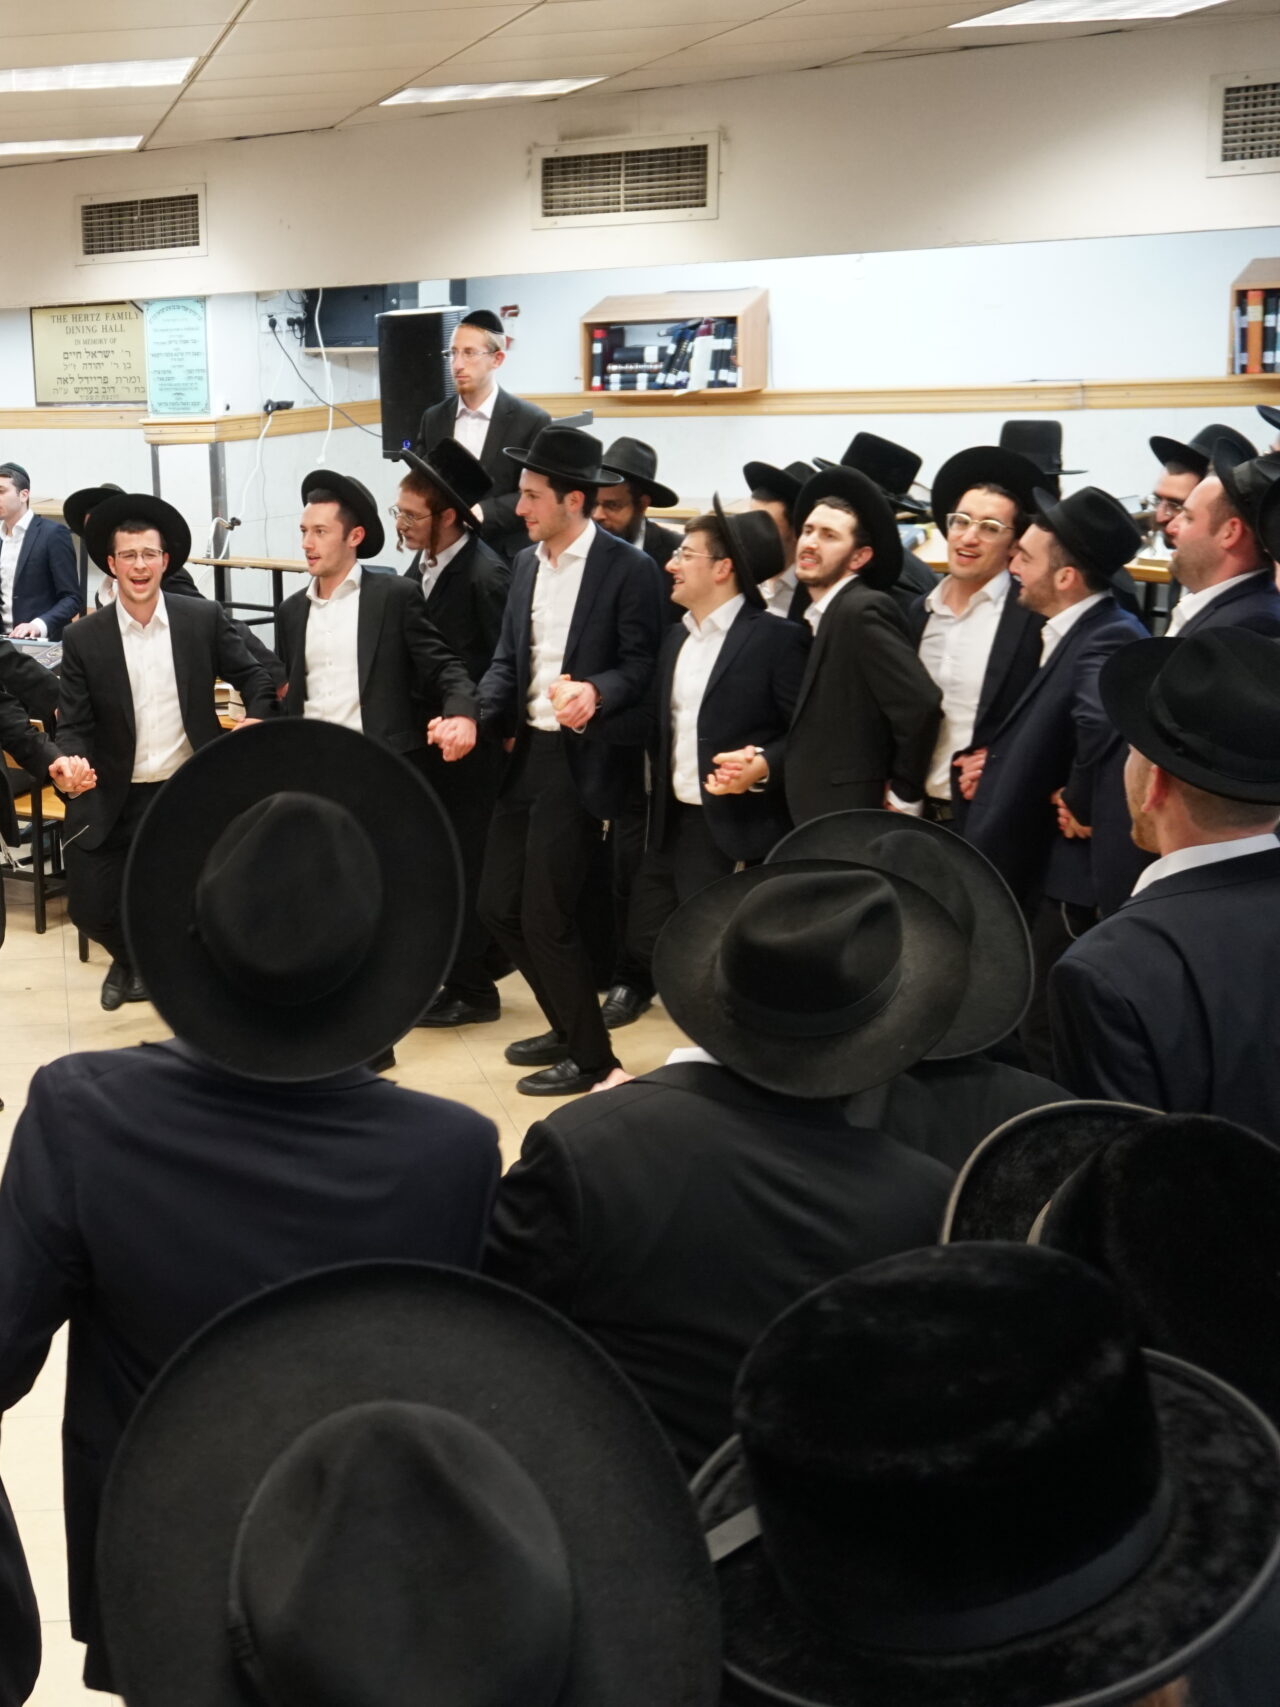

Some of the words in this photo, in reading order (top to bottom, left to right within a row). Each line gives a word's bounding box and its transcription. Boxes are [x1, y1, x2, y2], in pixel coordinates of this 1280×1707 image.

[51, 315, 68, 324] THE
[71, 313, 101, 323] HERTZ
[105, 312, 139, 321] FAMILY
[65, 325, 98, 335] DINING
[101, 324, 125, 333] HALL
[63, 350, 82, 360] חיים
[84, 348, 115, 359] ישראל
[56, 373, 75, 385] לאה
